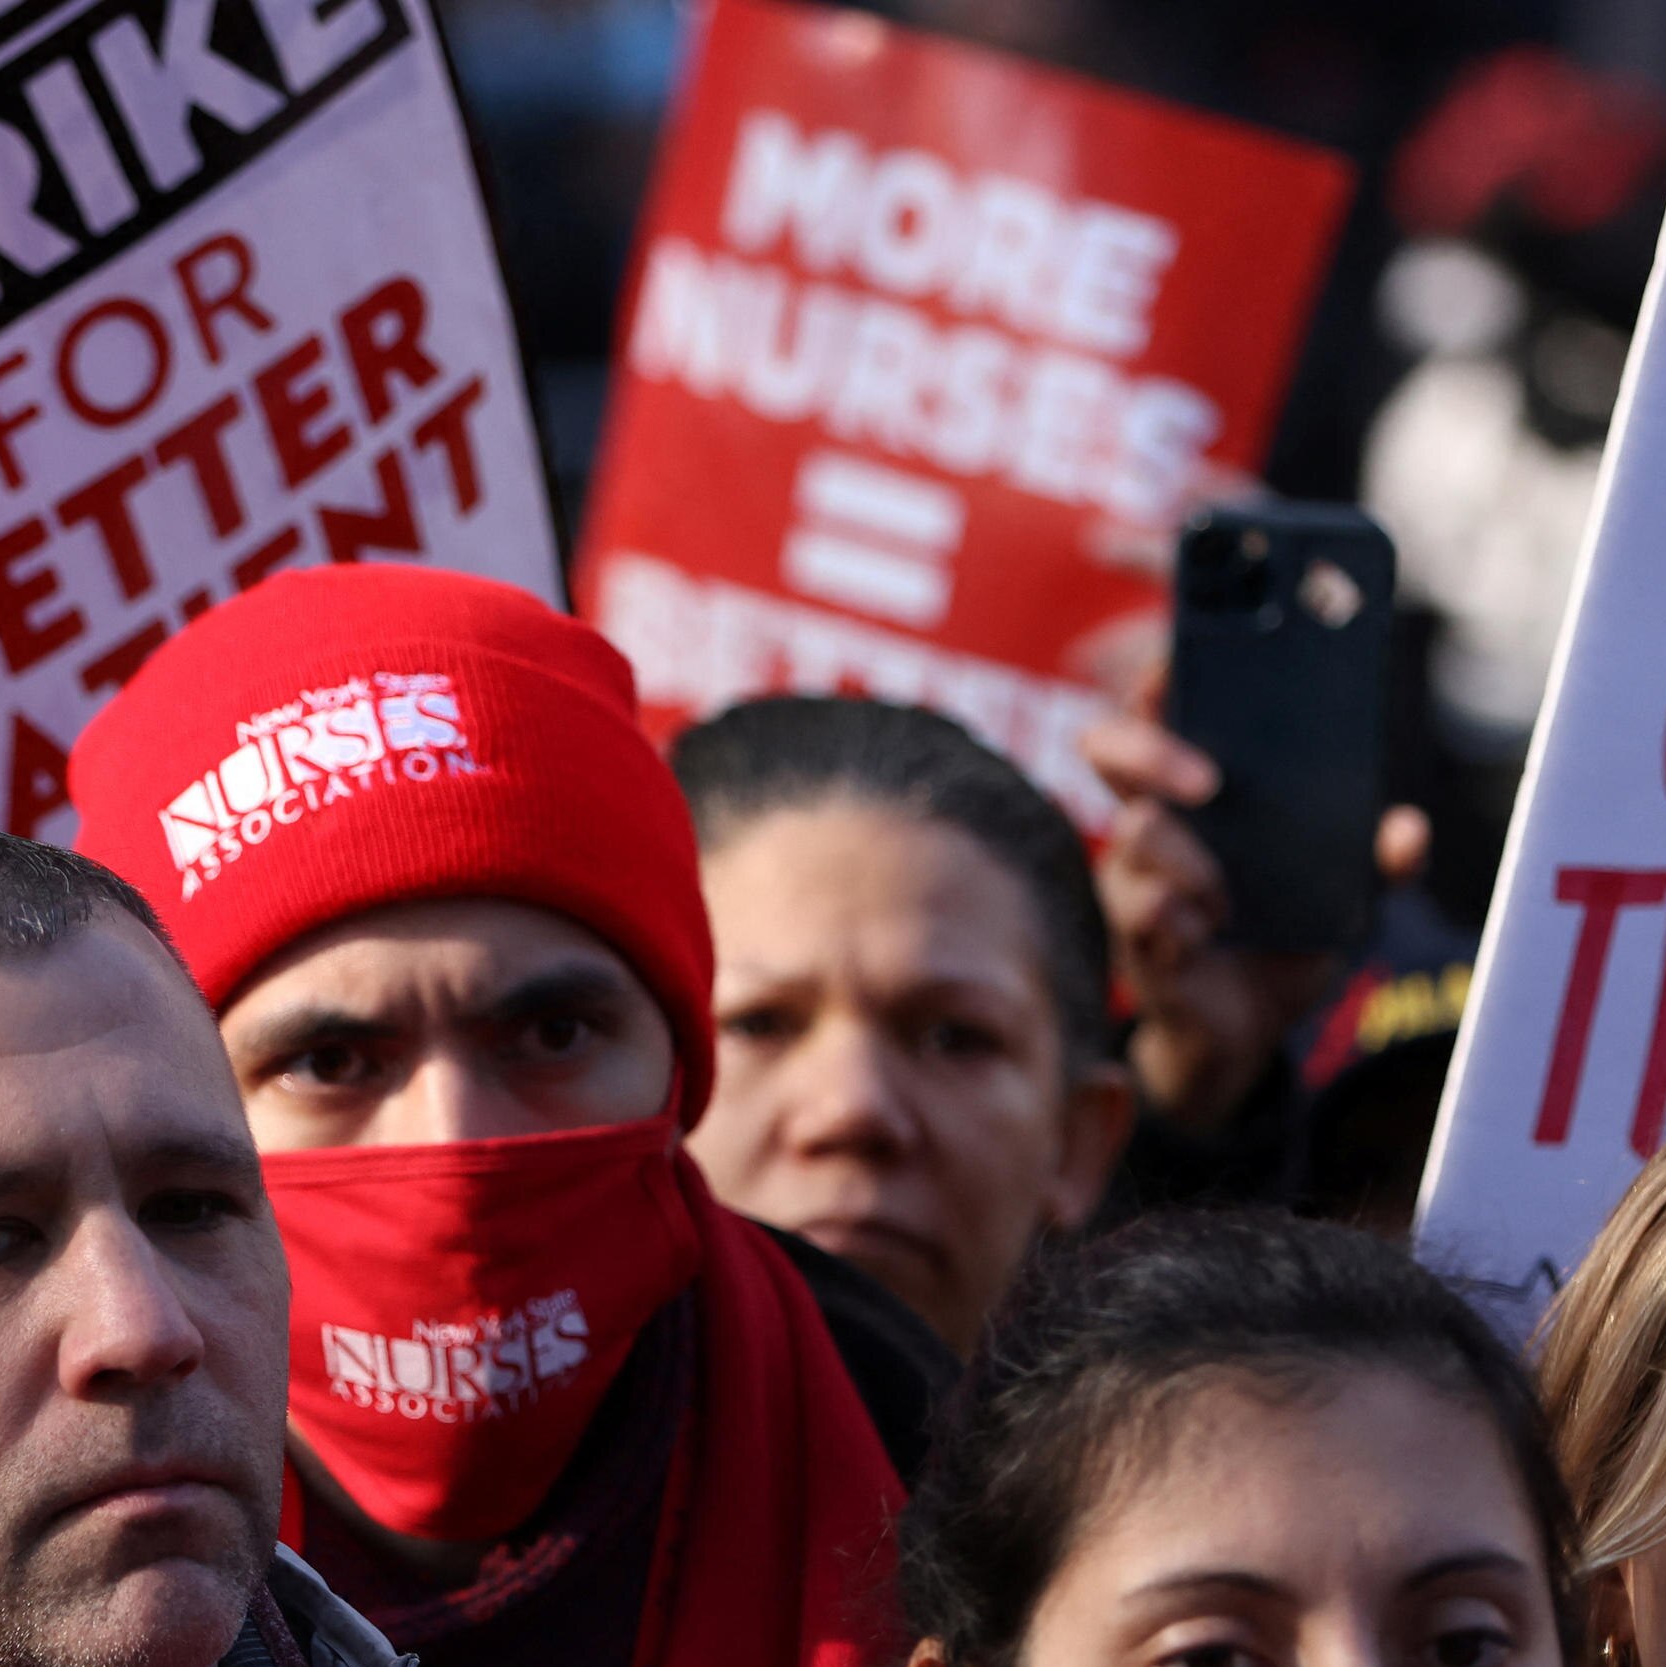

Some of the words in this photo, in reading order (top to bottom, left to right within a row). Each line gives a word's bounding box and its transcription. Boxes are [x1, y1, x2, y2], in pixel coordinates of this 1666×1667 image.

[721, 110, 1180, 356] MORE
[631, 238, 1219, 528] NURSES
[158, 692, 463, 871] NURSES
[235, 699, 304, 746] New
[299, 676, 373, 709] York
[181, 751, 483, 903] ASSOCIATION
[321, 1310, 590, 1400] NURSES
